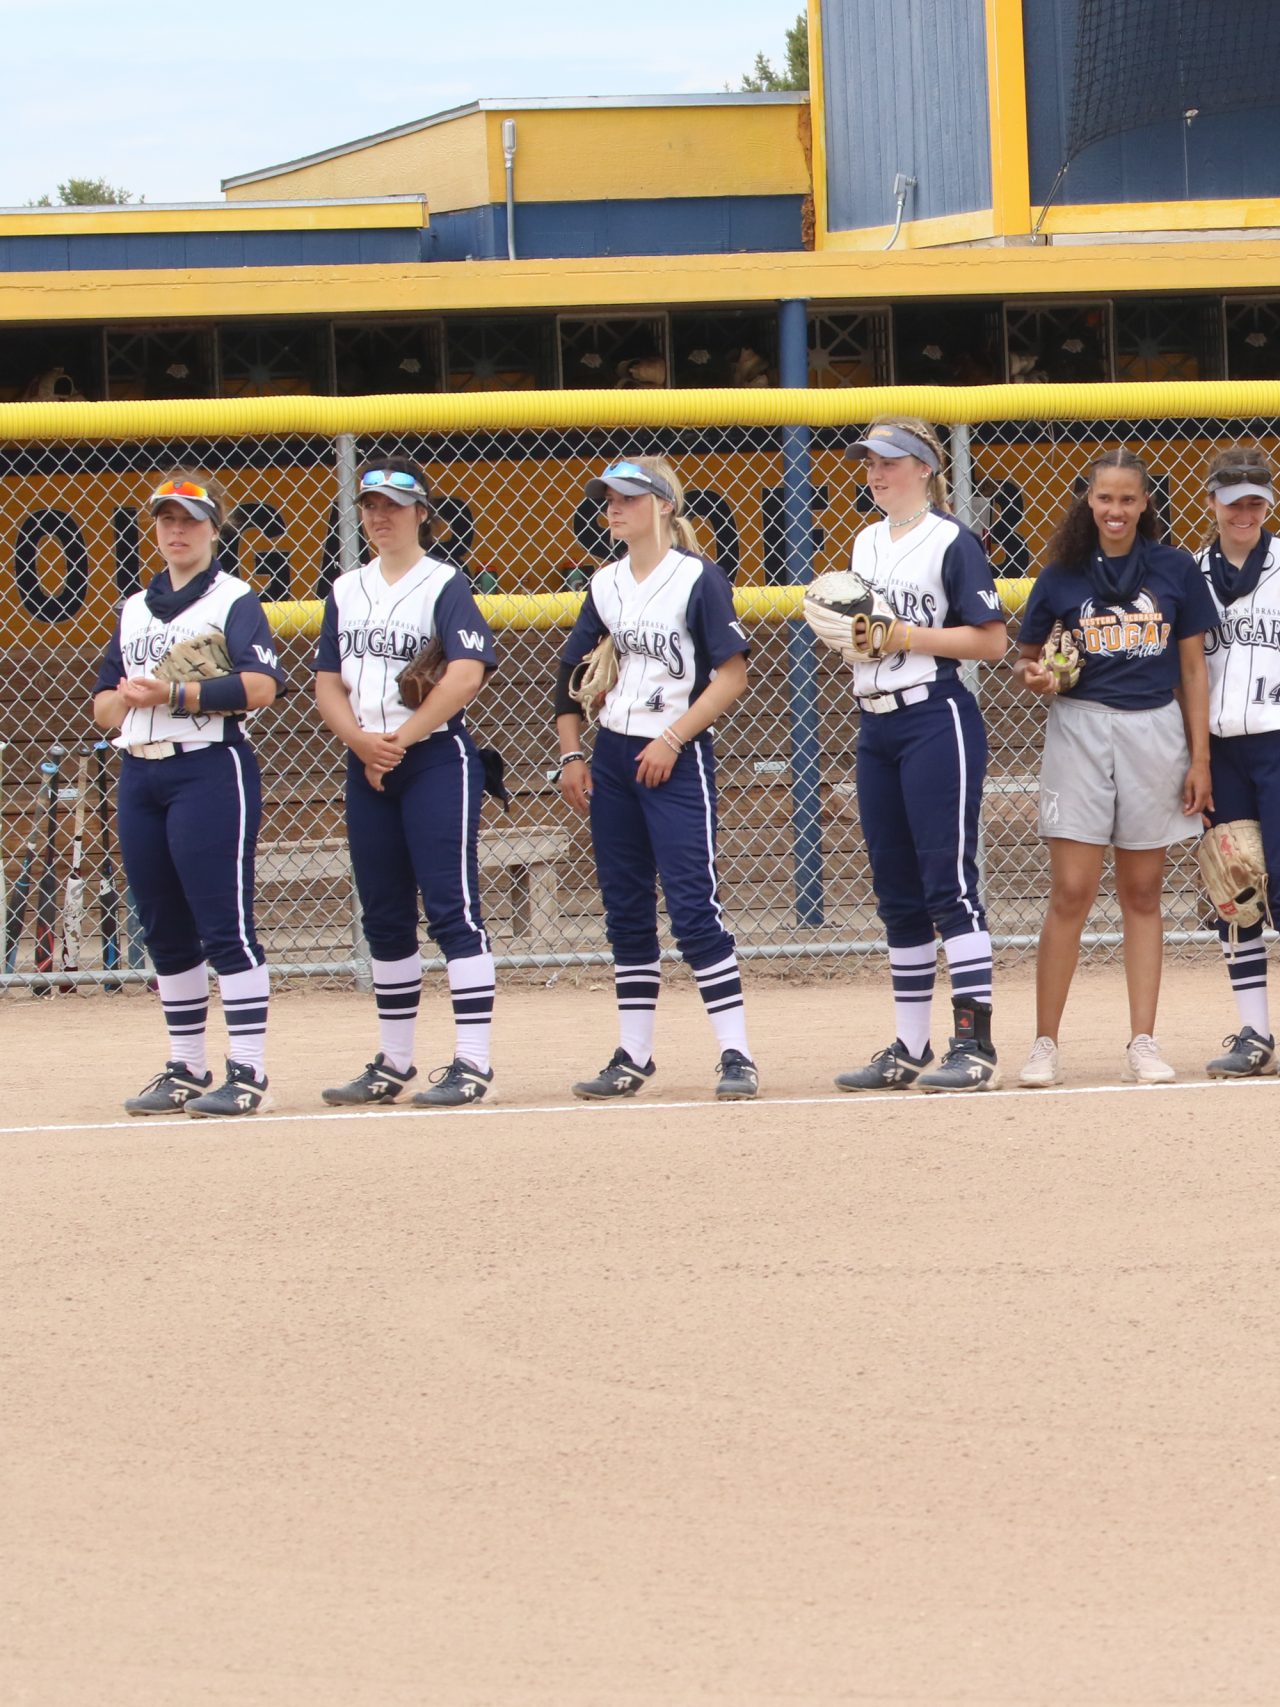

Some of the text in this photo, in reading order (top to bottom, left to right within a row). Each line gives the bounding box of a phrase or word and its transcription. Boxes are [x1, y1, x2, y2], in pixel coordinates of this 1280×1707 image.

[457, 629, 485, 652] W
[252, 644, 278, 669] W
[646, 685, 666, 713] 4
